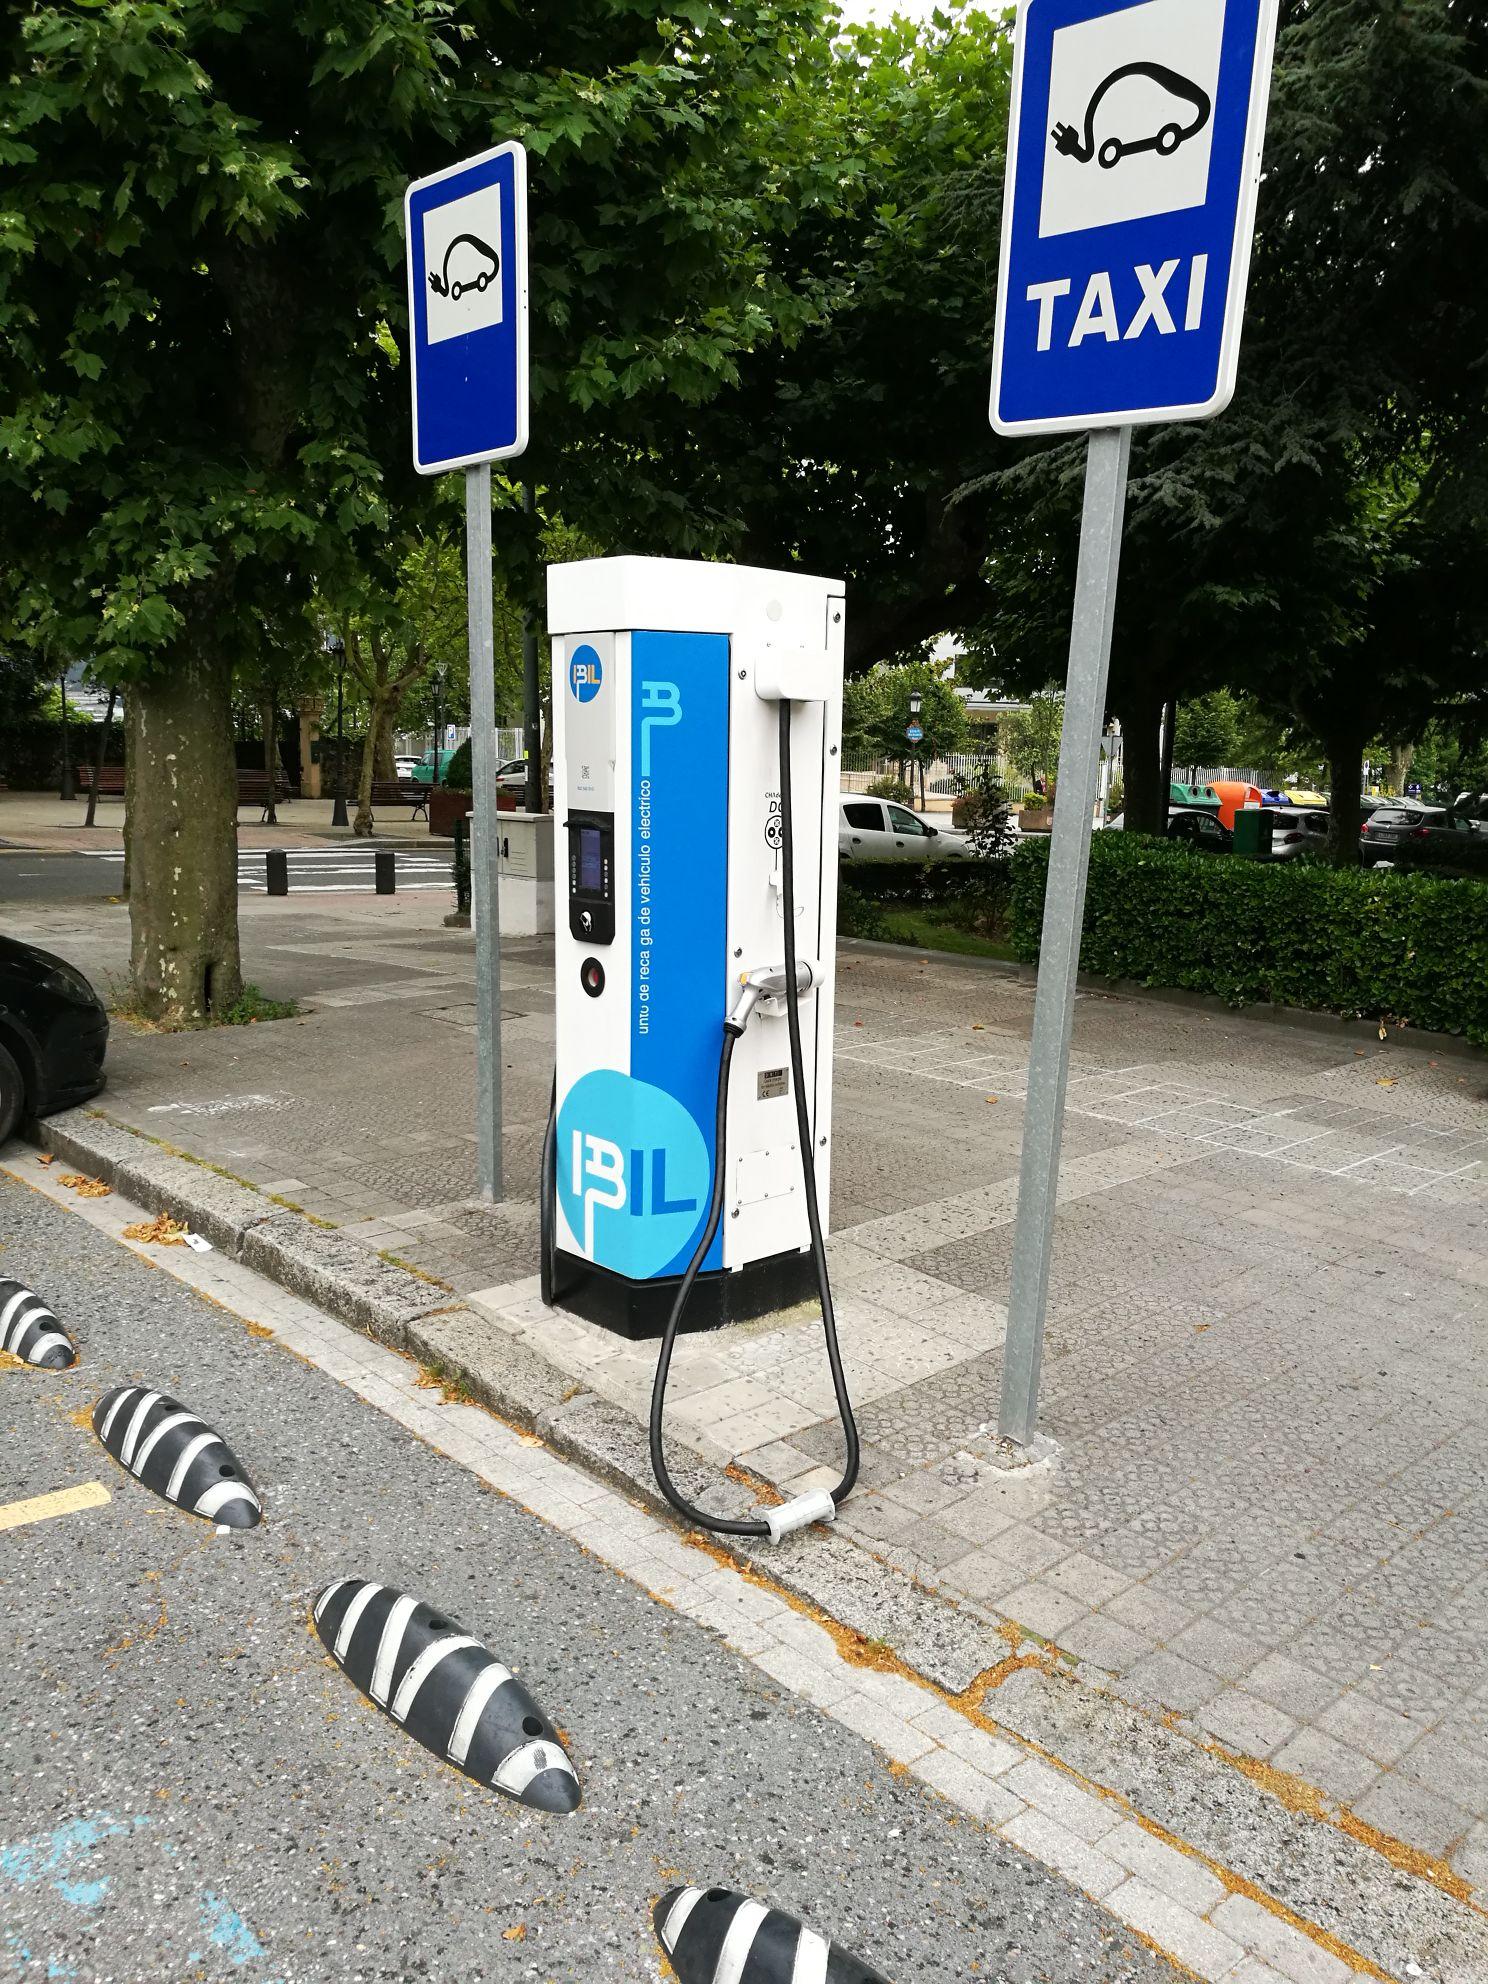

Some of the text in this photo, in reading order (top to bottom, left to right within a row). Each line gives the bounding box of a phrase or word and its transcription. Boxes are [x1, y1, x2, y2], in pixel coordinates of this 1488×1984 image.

[1026, 254, 1209, 352] TAXI
[638, 844, 651, 904] vehículo
[638, 907, 651, 925] de
[639, 984, 649, 1001] de
